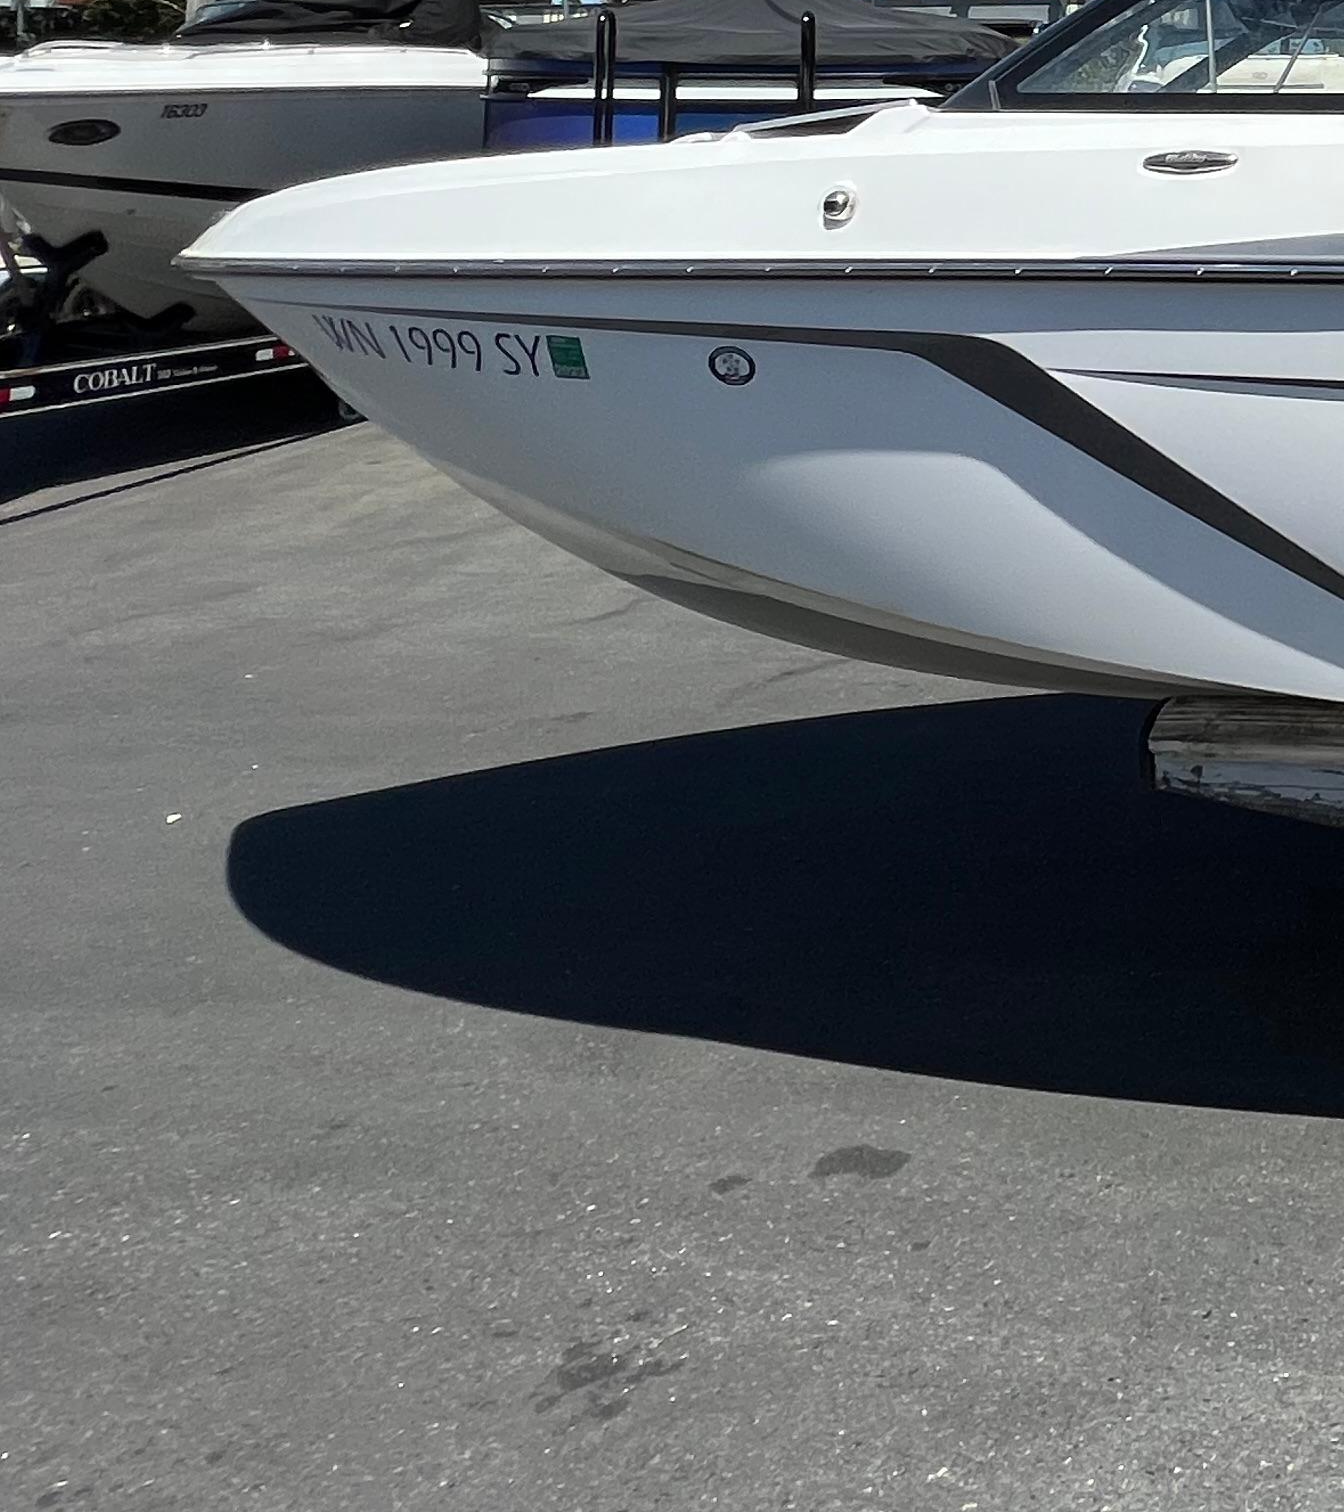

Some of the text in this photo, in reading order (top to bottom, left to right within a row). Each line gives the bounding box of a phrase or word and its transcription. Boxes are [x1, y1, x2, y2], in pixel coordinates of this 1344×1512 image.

[311, 313, 386, 360] WN
[389, 324, 482, 372] 1999
[494, 332, 542, 378] SY
[73, 363, 157, 394] COBALT
